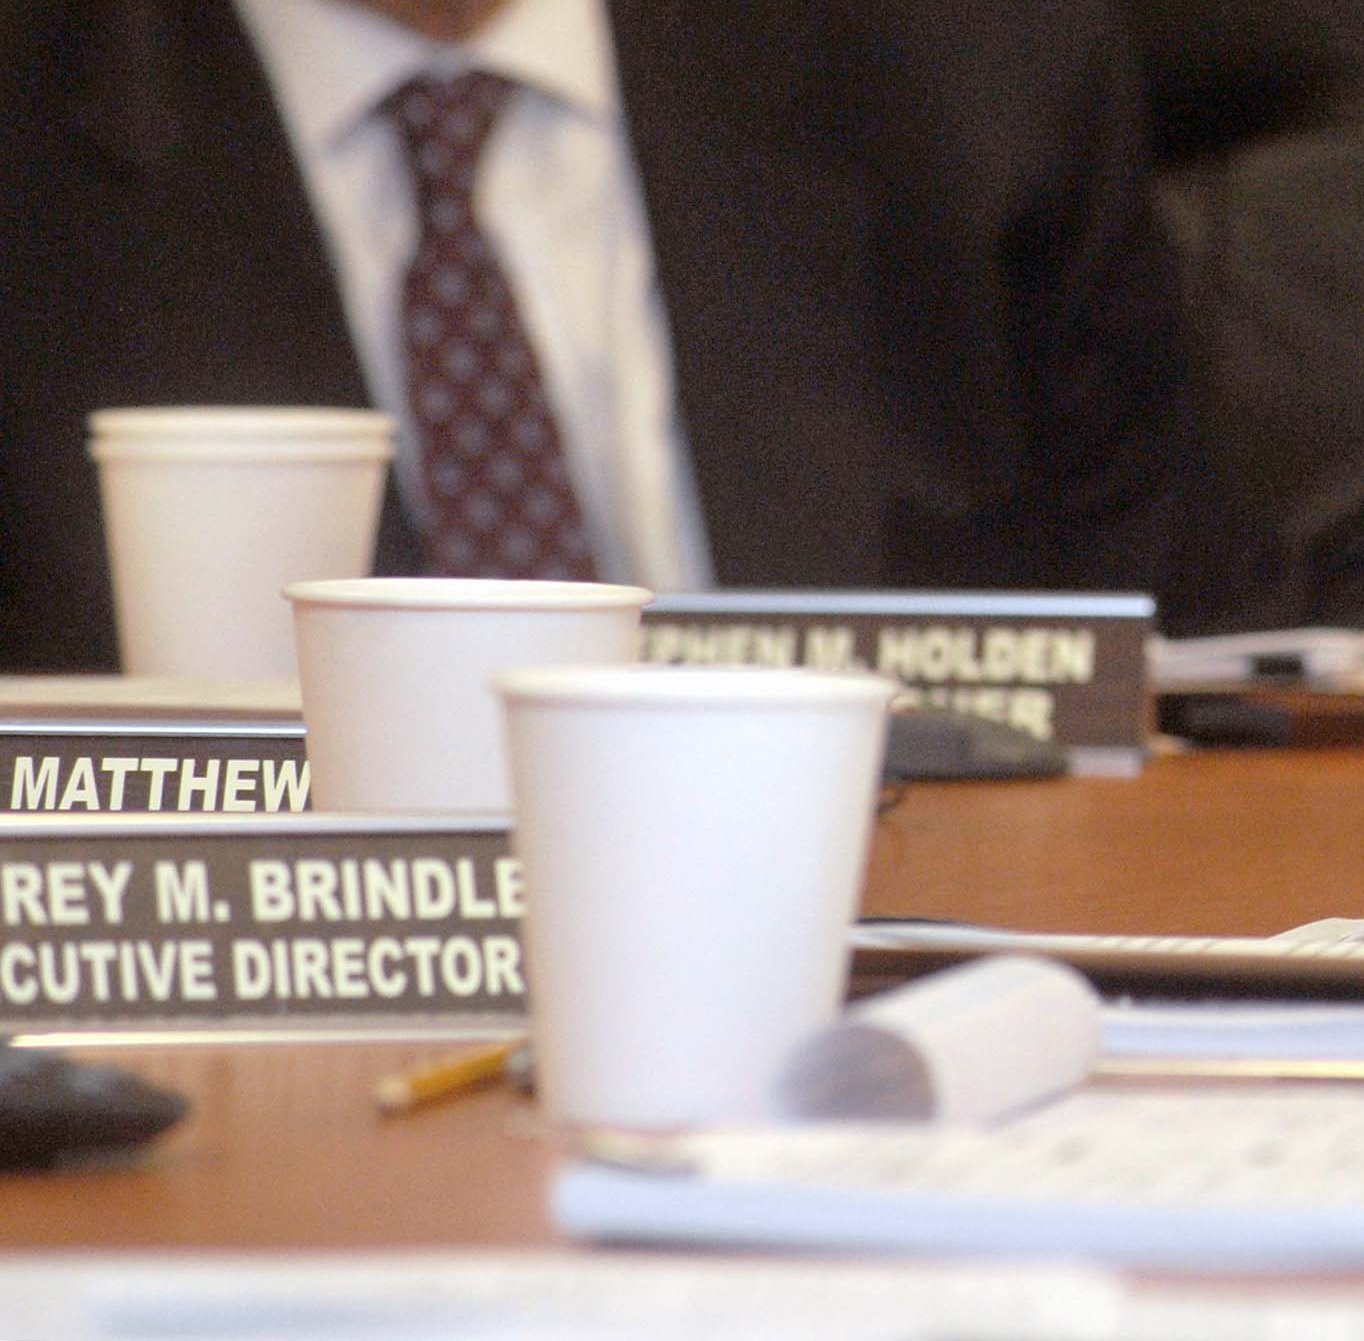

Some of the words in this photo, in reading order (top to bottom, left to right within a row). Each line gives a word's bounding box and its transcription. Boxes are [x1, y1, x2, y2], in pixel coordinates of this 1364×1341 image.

[637, 625, 797, 665] PHEN
[878, 627, 1095, 685] HOLDEN
[11, 756, 311, 812] MATTHEW
[0, 861, 133, 926] REY
[154, 861, 231, 924] M.
[250, 859, 526, 922] BRINDLE
[0, 941, 217, 1005] CUTIVE
[231, 936, 526, 1000] DIRECTOR
